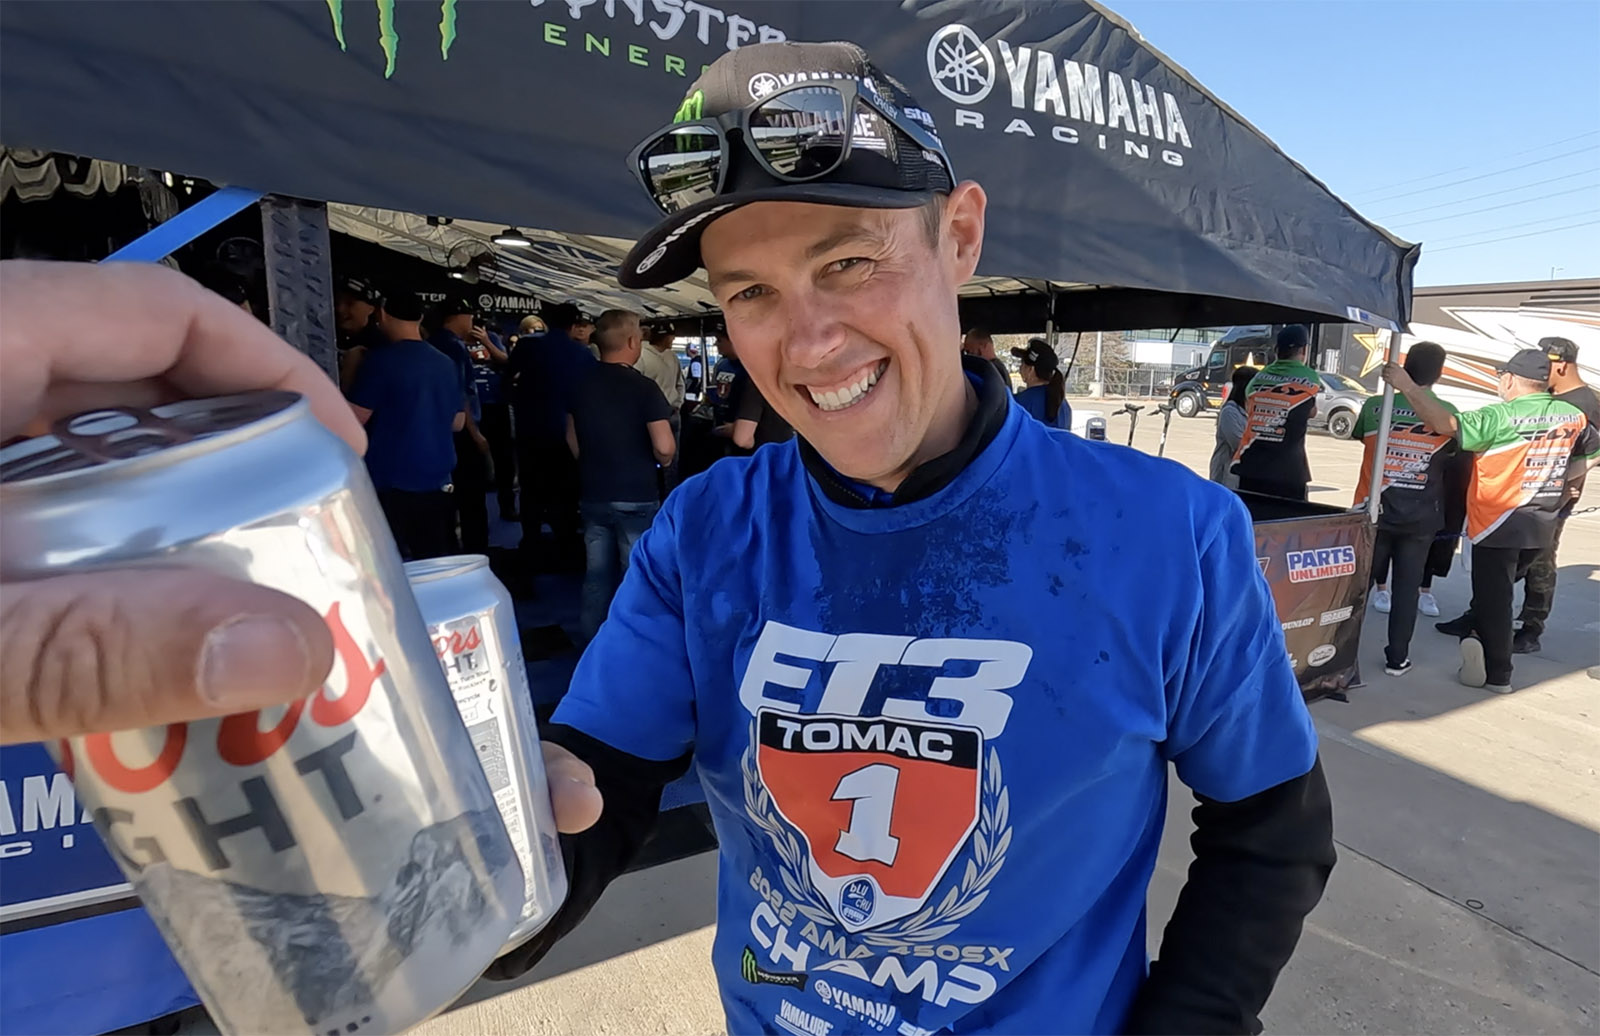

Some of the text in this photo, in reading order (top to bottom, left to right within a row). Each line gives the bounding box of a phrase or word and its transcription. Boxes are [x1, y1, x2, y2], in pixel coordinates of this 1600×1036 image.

[544, 23, 711, 77] ENER
[997, 40, 1192, 148] YAMAHA
[955, 109, 1184, 167] RACING
[494, 296, 542, 310] YAMAHA
[1289, 547, 1354, 570] PARTS
[1291, 563, 1354, 581] UNLIMITED
[739, 620, 1033, 740] ET3
[777, 720, 953, 761] TOMAC
[830, 763, 900, 865] 1
[749, 866, 1015, 971] 2022 AMA 450SX
[750, 901, 997, 1008] CHAMP
[781, 999, 834, 1036] YAMALUBE
[822, 998, 883, 1031] RACING
[832, 986, 896, 1027] YAMAHA
